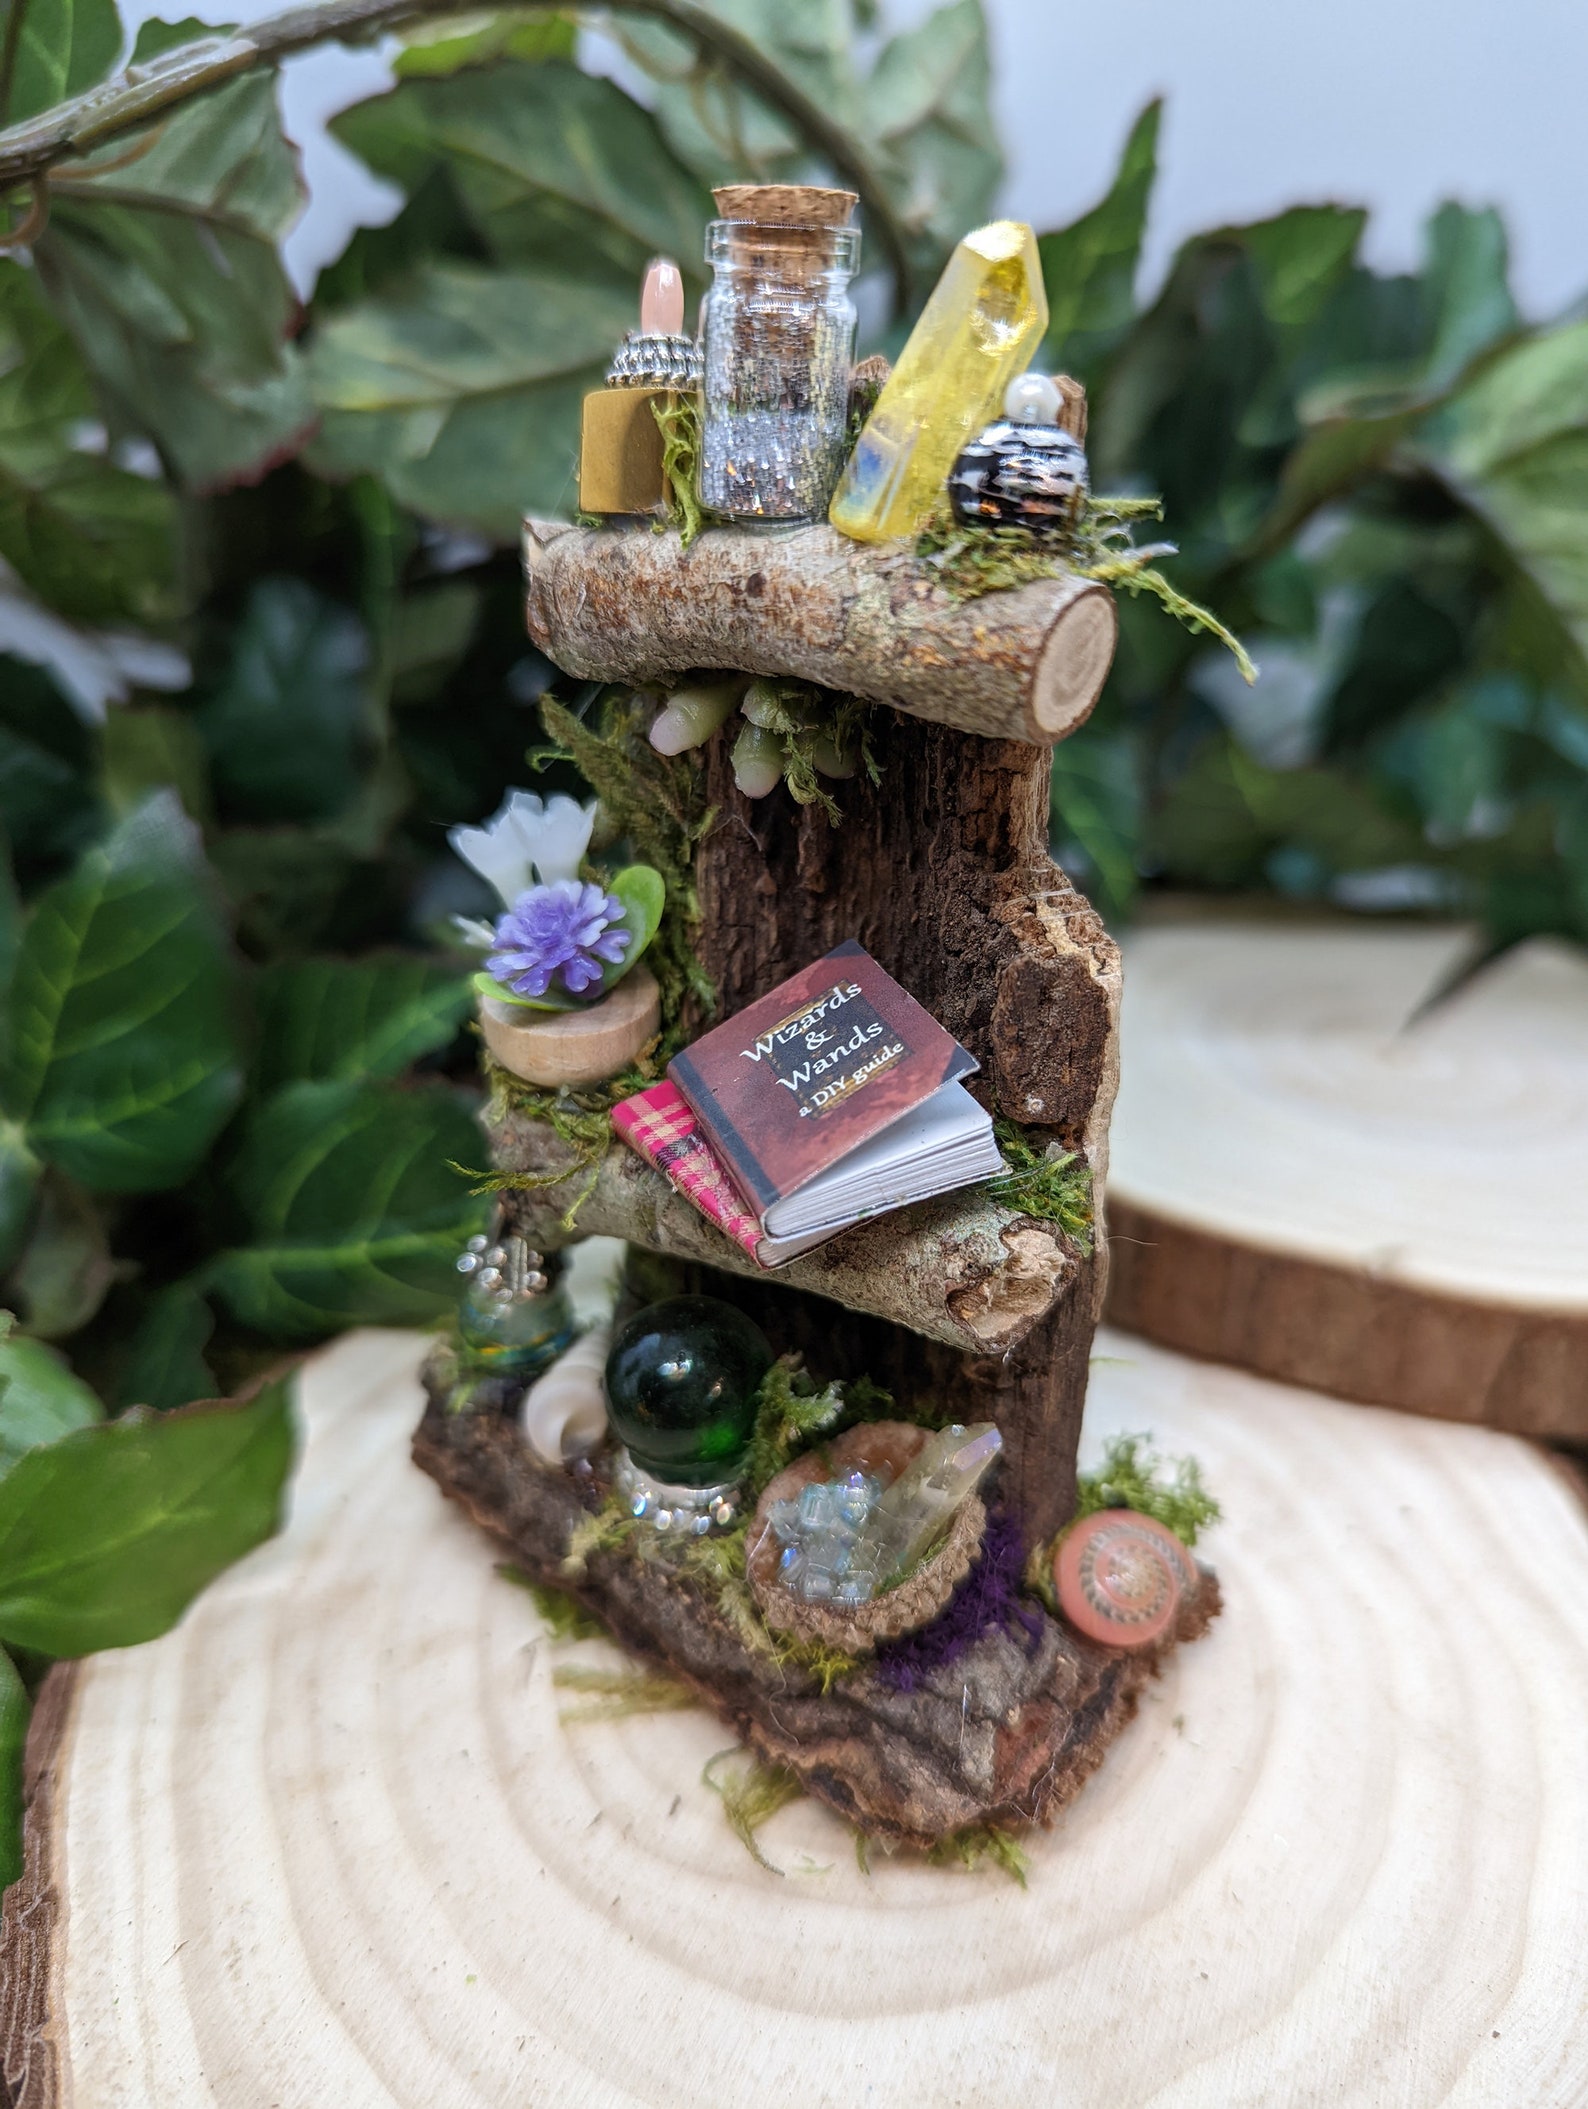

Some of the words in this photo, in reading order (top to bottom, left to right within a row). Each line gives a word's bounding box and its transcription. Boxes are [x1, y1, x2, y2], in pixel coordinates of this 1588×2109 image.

[739, 982, 863, 1063] Wizards
[775, 1020, 884, 1092] Wands
[804, 1028, 835, 1051] &
[798, 1105, 811, 1118] a
[810, 1076, 849, 1107] DIY
[851, 1043, 905, 1085] guide
